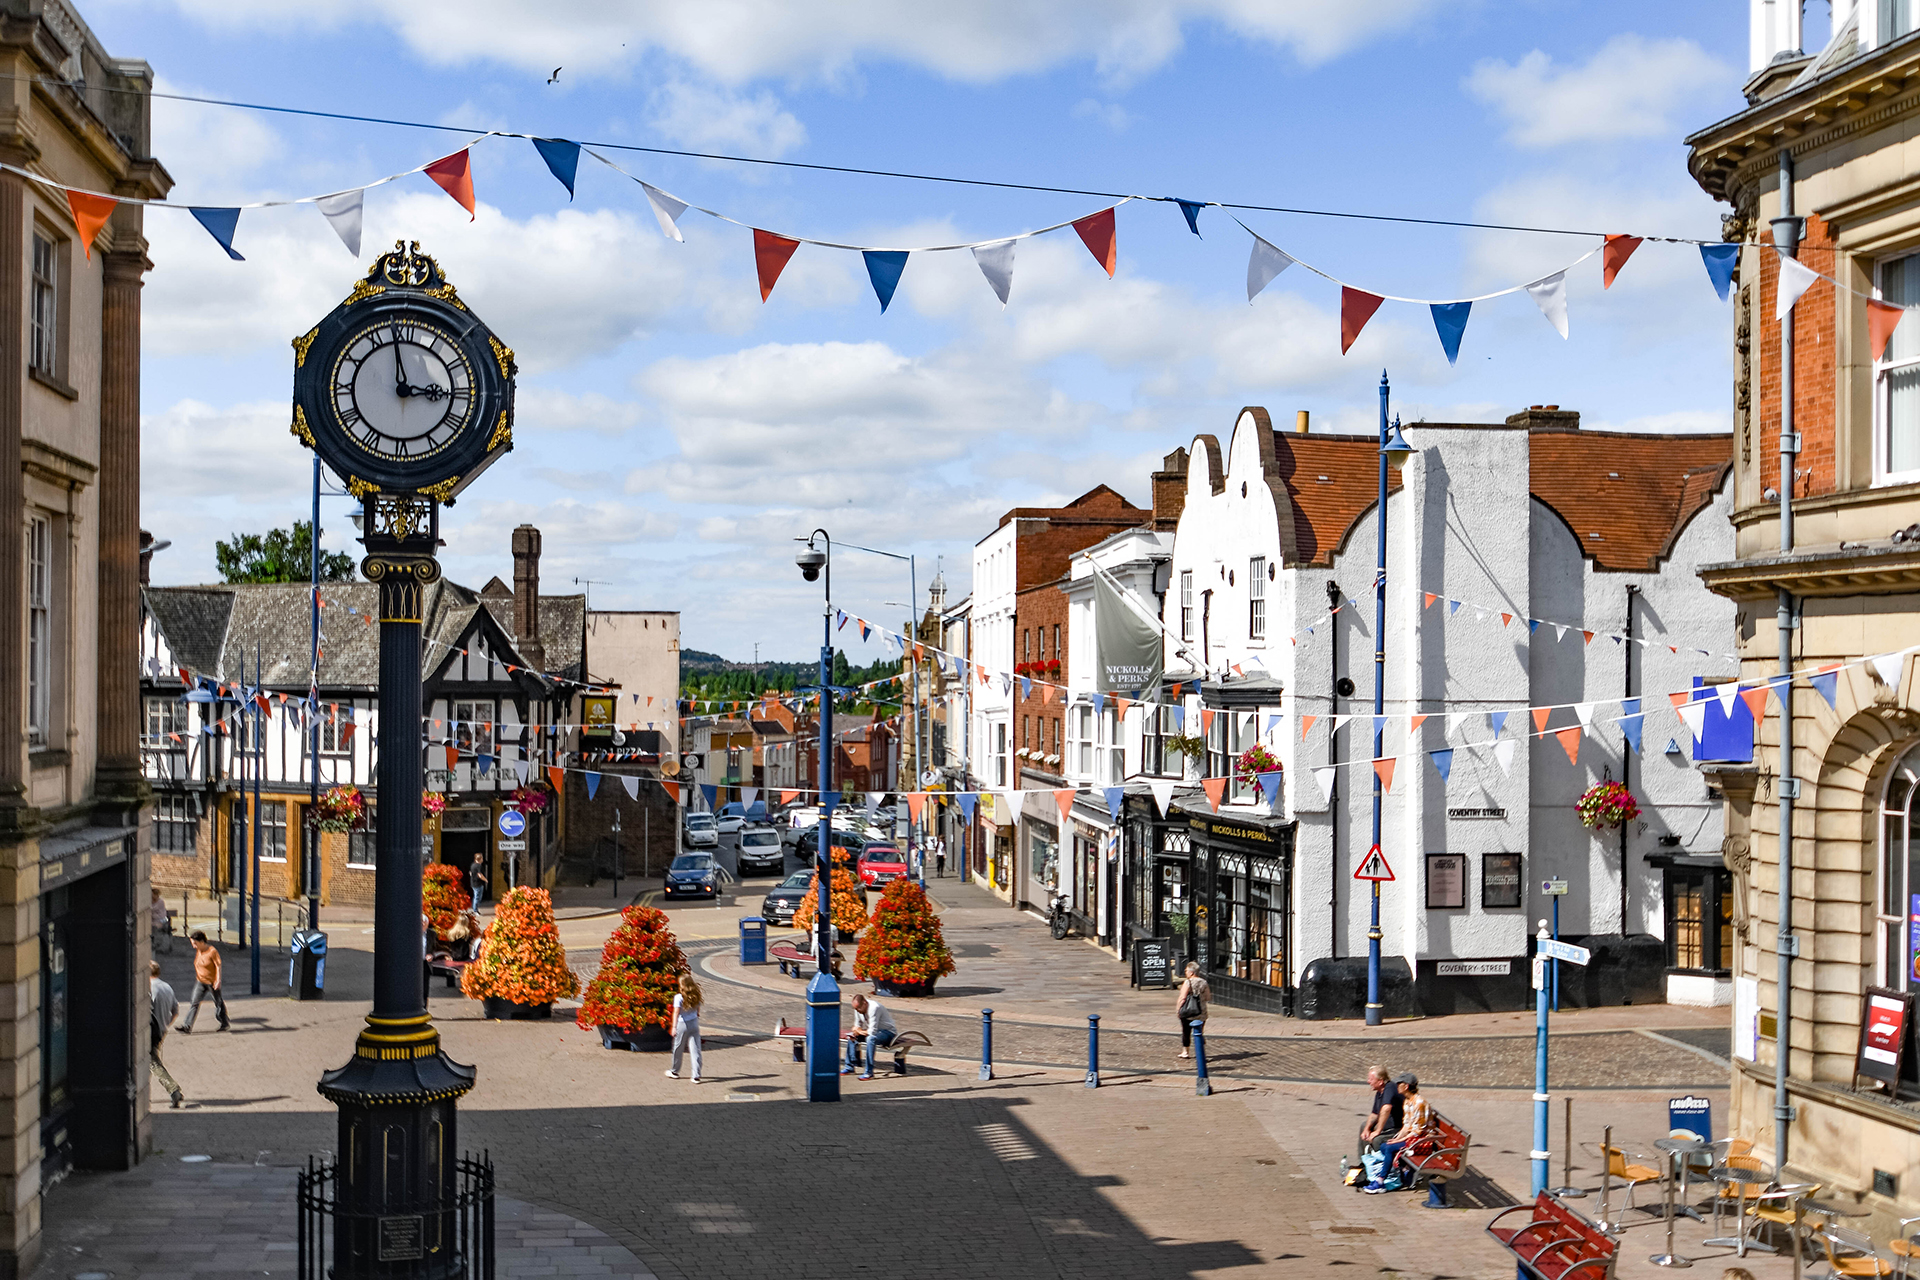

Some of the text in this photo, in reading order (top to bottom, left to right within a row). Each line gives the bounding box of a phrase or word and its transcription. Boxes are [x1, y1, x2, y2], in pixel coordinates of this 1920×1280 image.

[365, 330, 383, 348] XI
[343, 350, 361, 368] X
[446, 357, 465, 371] II
[336, 381, 353, 396] IX
[453, 386, 470, 400] III
[395, 440, 409, 457] VI
[426, 434, 440, 449] V
[1106, 665, 1152, 674] NICKOLLS
[1109, 674, 1150, 683] & PERKS
[616, 747, 643, 756] PIZZA
[1448, 808, 1506, 817] COVENTRY STREET
[1212, 824, 1241, 837] NICKOLLS
[1241, 829, 1247, 838] &
[1247, 830, 1267, 842] PERKS
[1440, 964, 1508, 973] COVENTRY STREET
[1670, 1096, 1710, 1109] LAVAZZA
